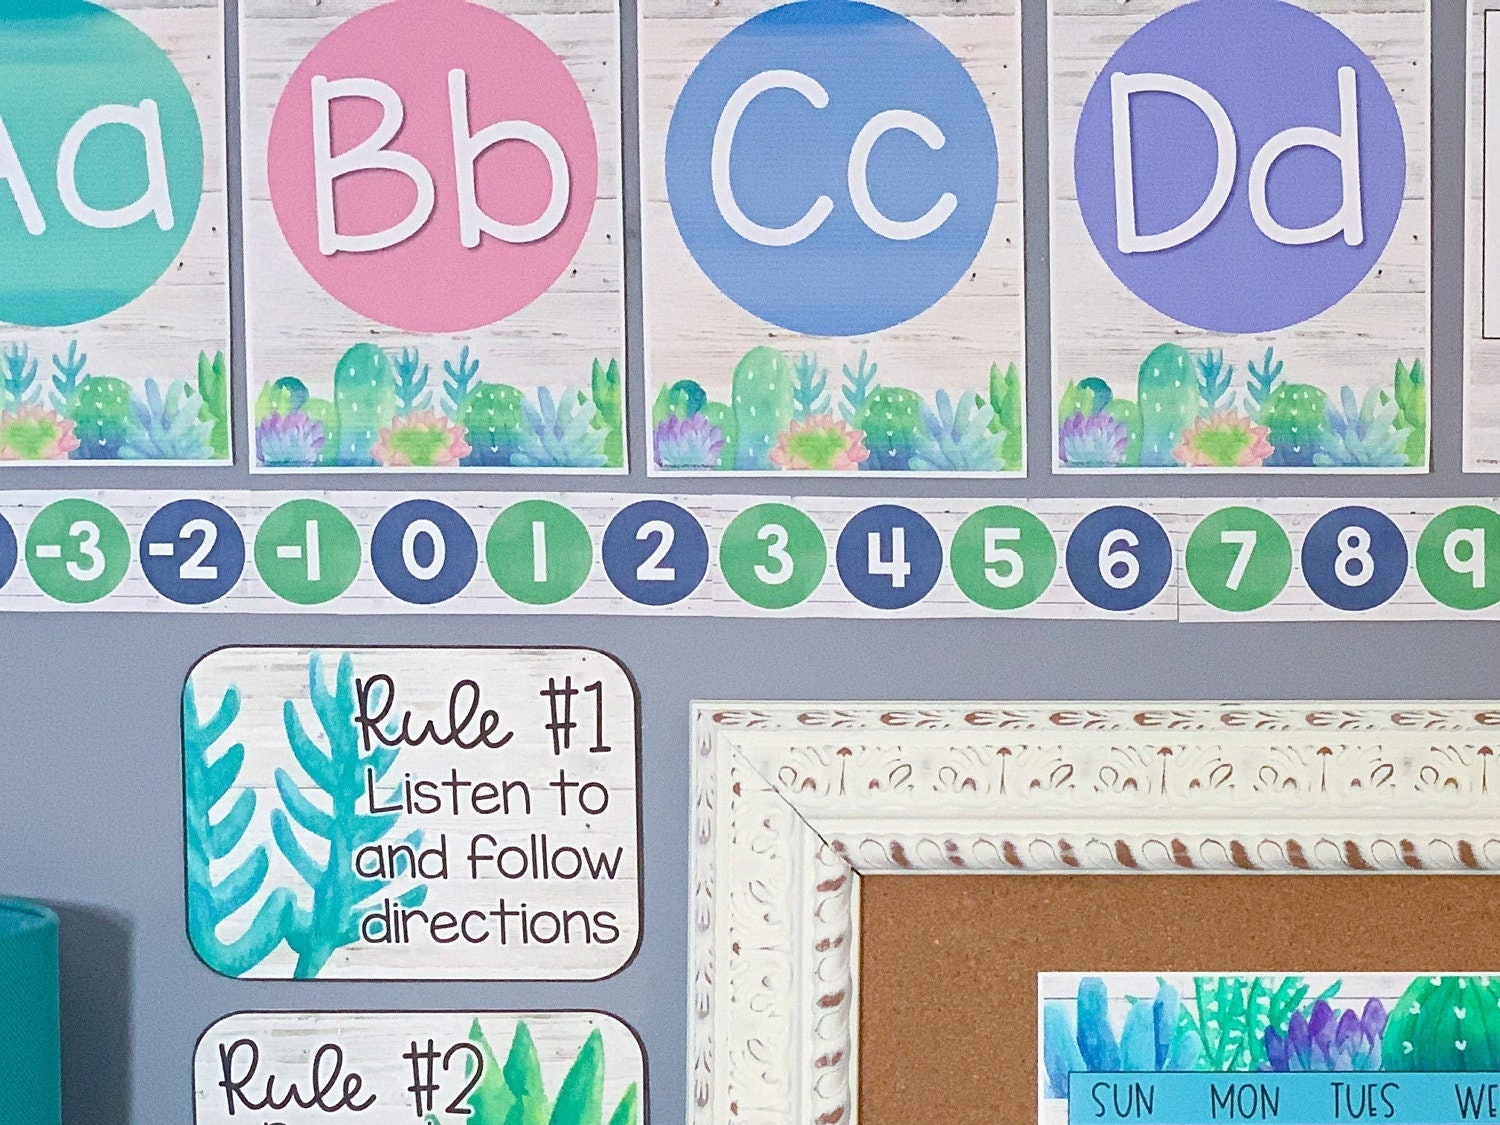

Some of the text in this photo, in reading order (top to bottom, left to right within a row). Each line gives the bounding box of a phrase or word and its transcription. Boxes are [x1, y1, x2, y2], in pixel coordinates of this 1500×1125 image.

[311, 68, 571, 256] Bb
[710, 69, 959, 247] Cc
[1110, 66, 1365, 254] Dd
[35, 520, 106, 582] -3
[148, 519, 219, 580] -2
[276, 520, 321, 582] -1
[401, 519, 446, 581] 0
[532, 521, 547, 582] 1
[635, 521, 677, 582] 2
[753, 523, 794, 585] 3
[868, 526, 912, 588] 4
[984, 527, 1025, 589] 5
[1097, 528, 1141, 590] 6
[1220, 530, 1258, 592] 7
[1334, 526, 1376, 588] 8
[1442, 528, 1487, 589] 9
[354, 673, 612, 755] Rule #1
[367, 768, 609, 816] Listen to
[355, 834, 624, 880] and follow
[361, 898, 621, 944] directions
[218, 1038, 485, 1118] Rule #2
[1091, 1082, 1155, 1118] SUN
[1210, 1083, 1280, 1119] MON
[1331, 1082, 1401, 1118] TUES
